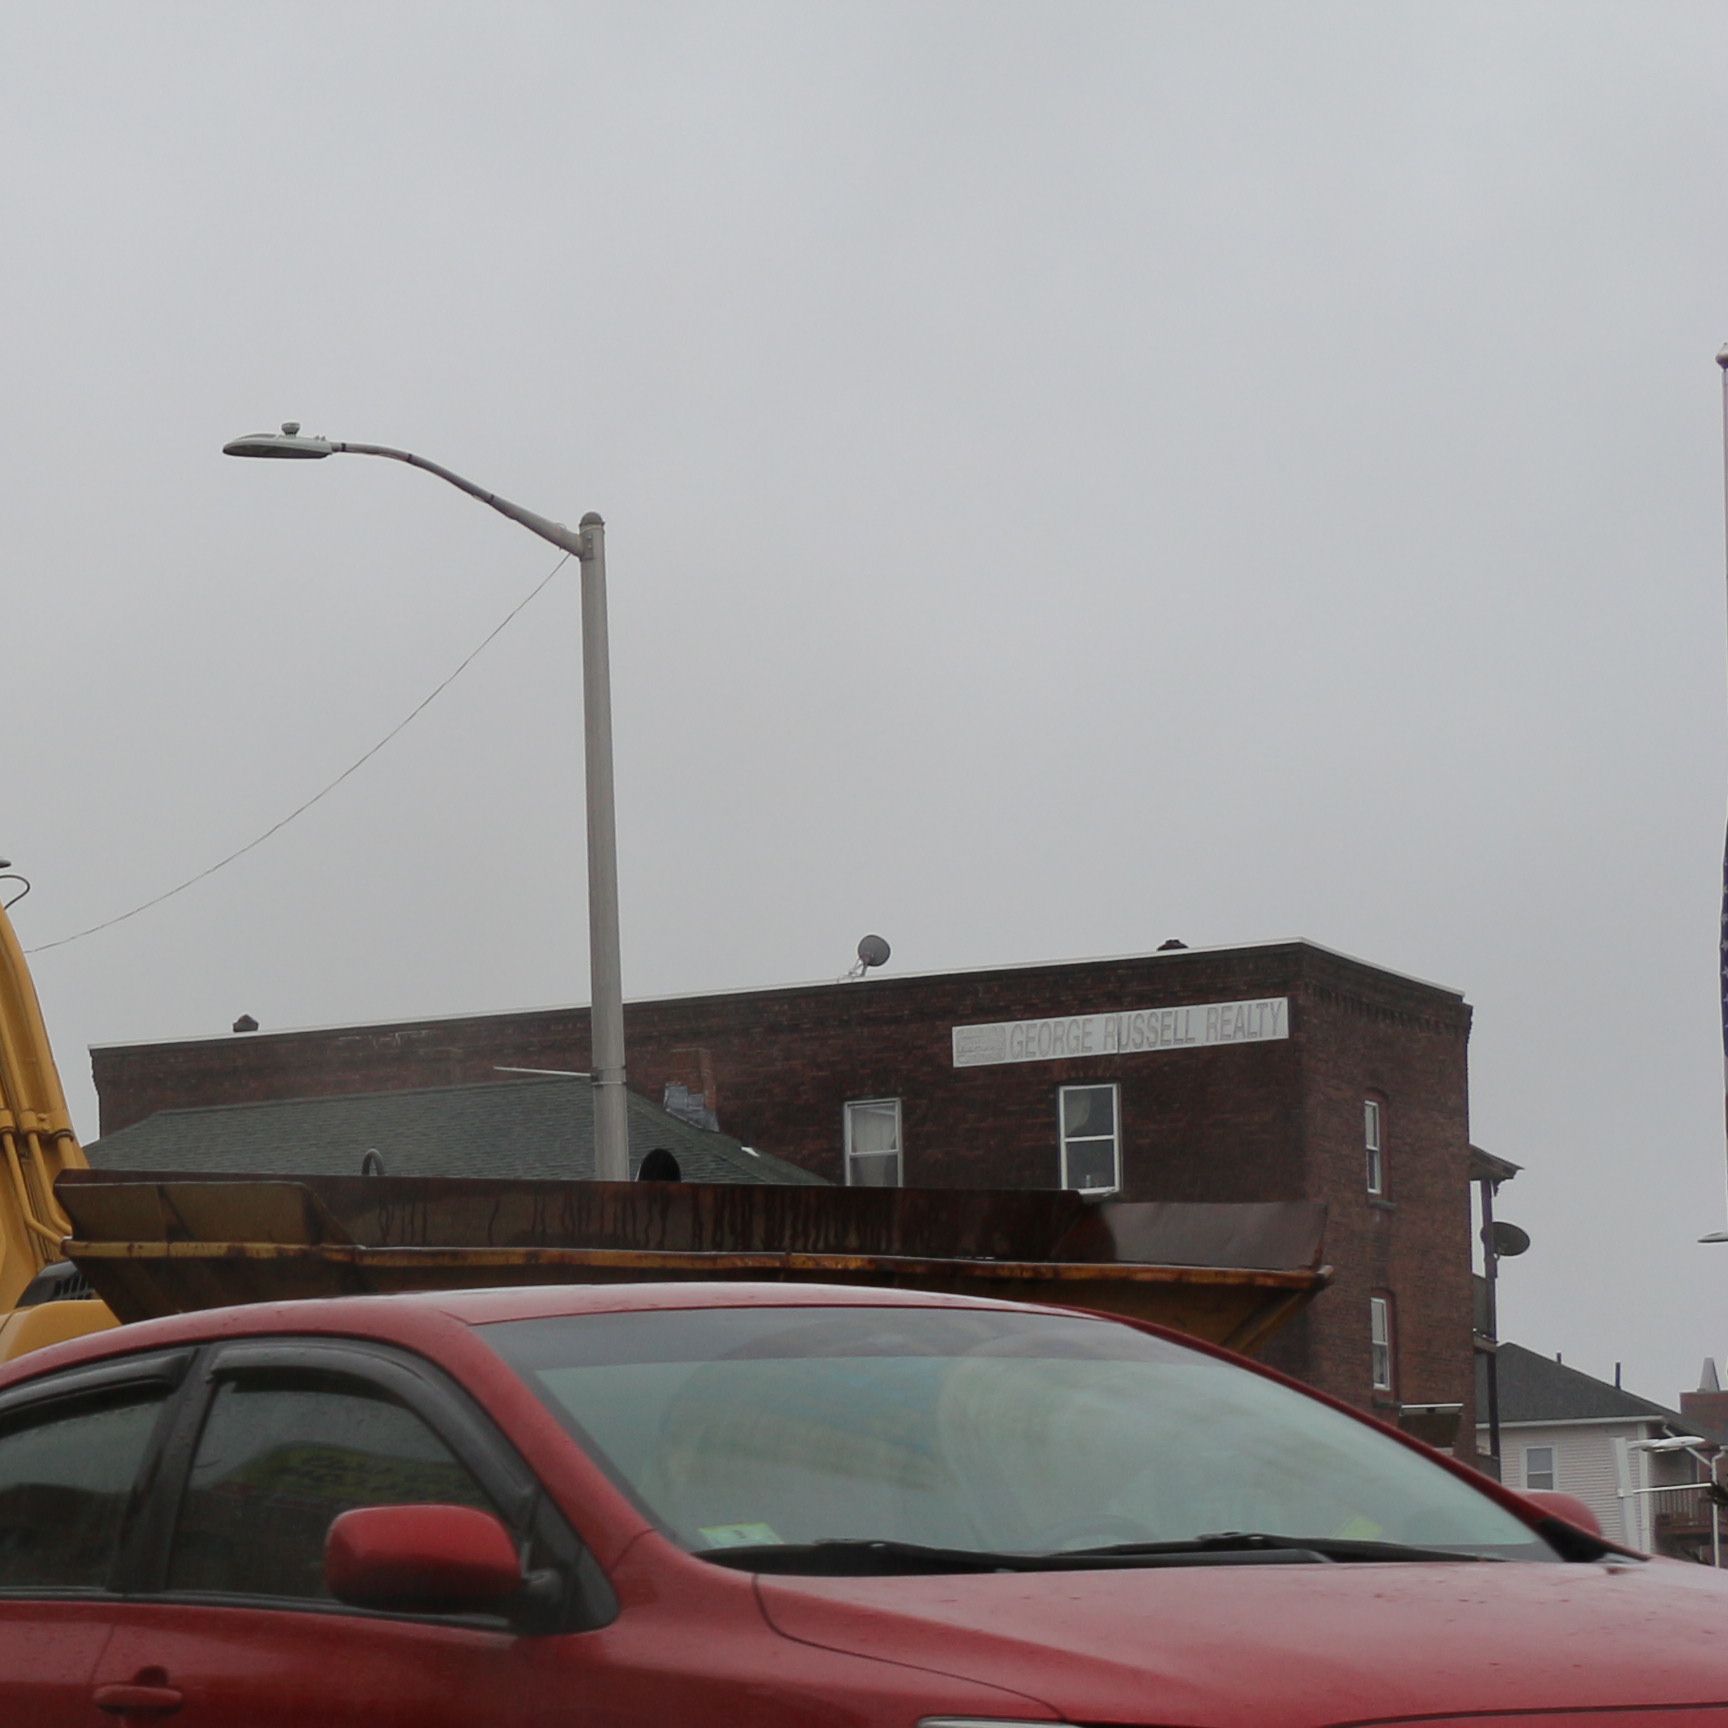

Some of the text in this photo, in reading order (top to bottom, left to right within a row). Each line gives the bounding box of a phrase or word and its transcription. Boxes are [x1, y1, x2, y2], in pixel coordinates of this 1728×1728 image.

[1009, 1018, 1093, 1059] GEORGE
[1103, 1009, 1195, 1051] RUSSELL
[1206, 1001, 1284, 1042] REALTY
